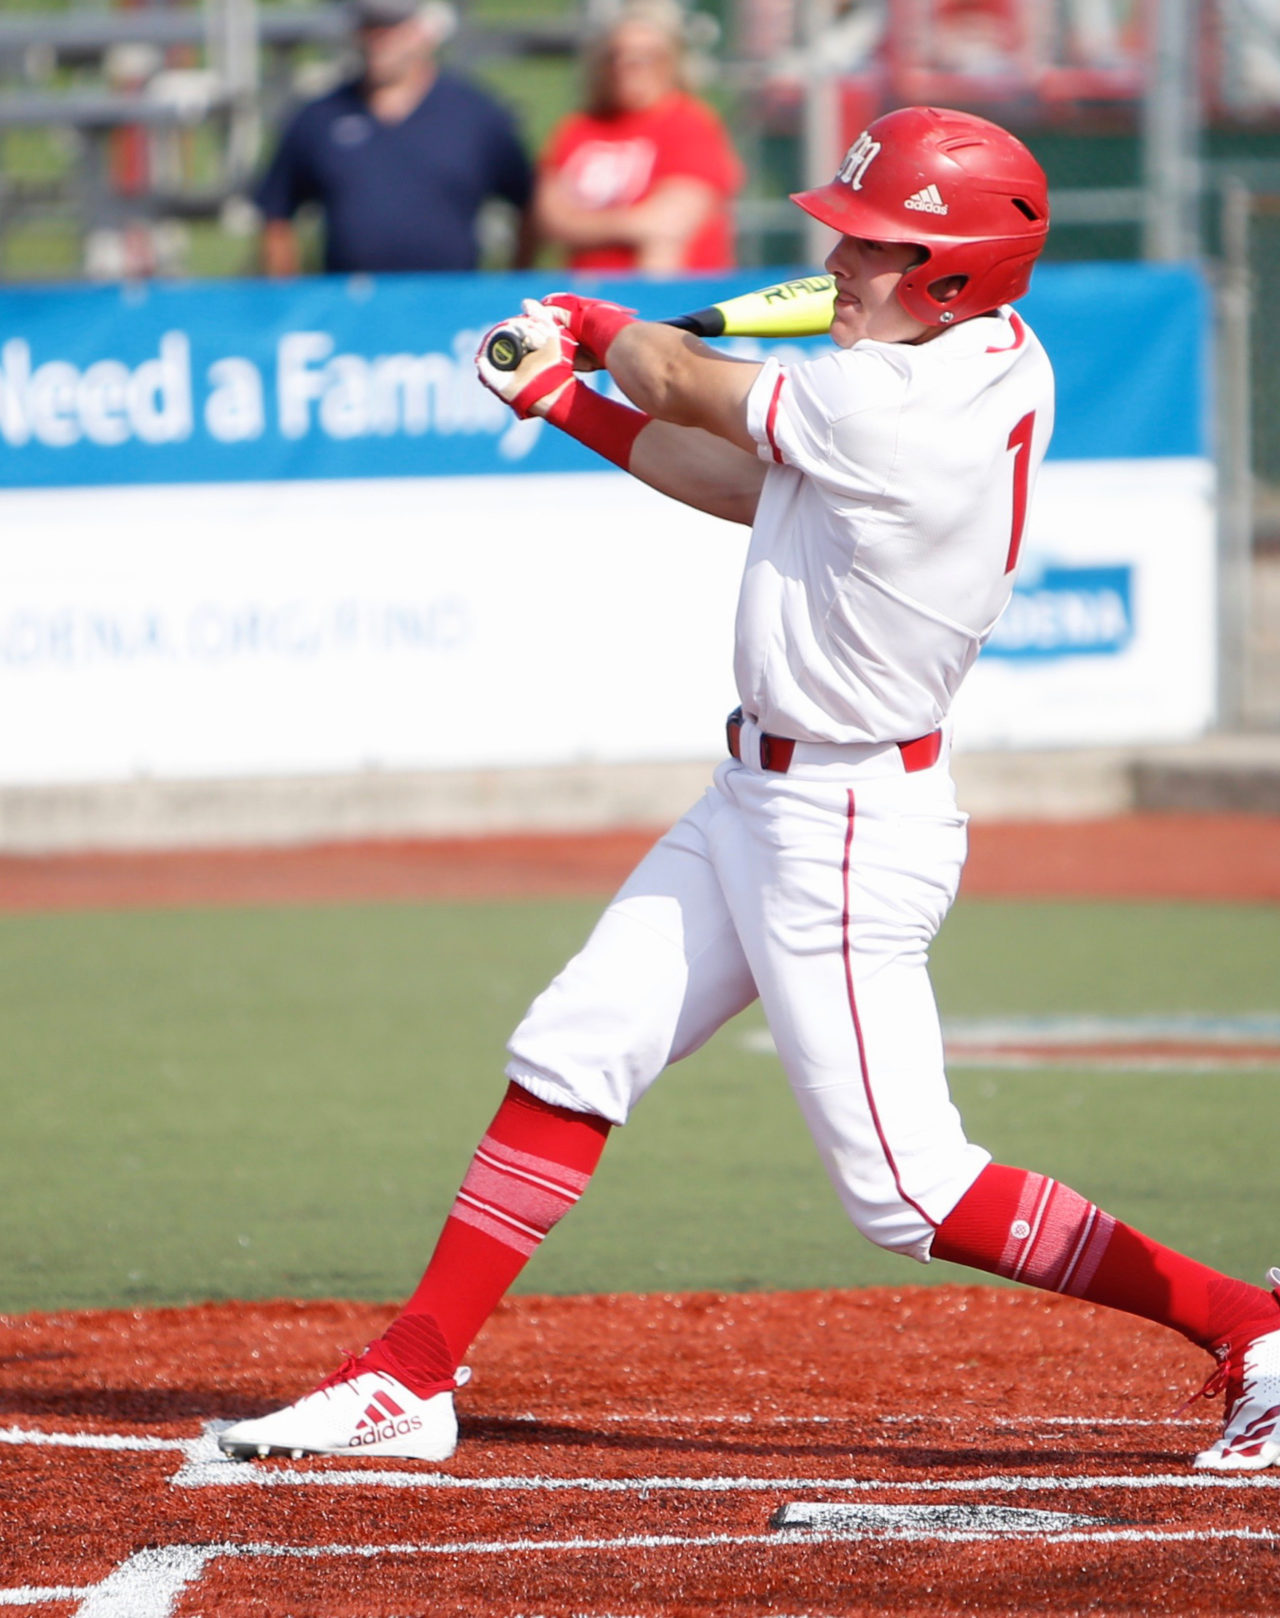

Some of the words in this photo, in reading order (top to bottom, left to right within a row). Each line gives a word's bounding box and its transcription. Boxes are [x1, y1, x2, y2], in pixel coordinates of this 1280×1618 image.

[904, 199, 948, 216] adidas
[204, 356, 265, 443] a
[1004, 409, 1036, 576] 1
[349, 1415, 423, 1447] adidas
